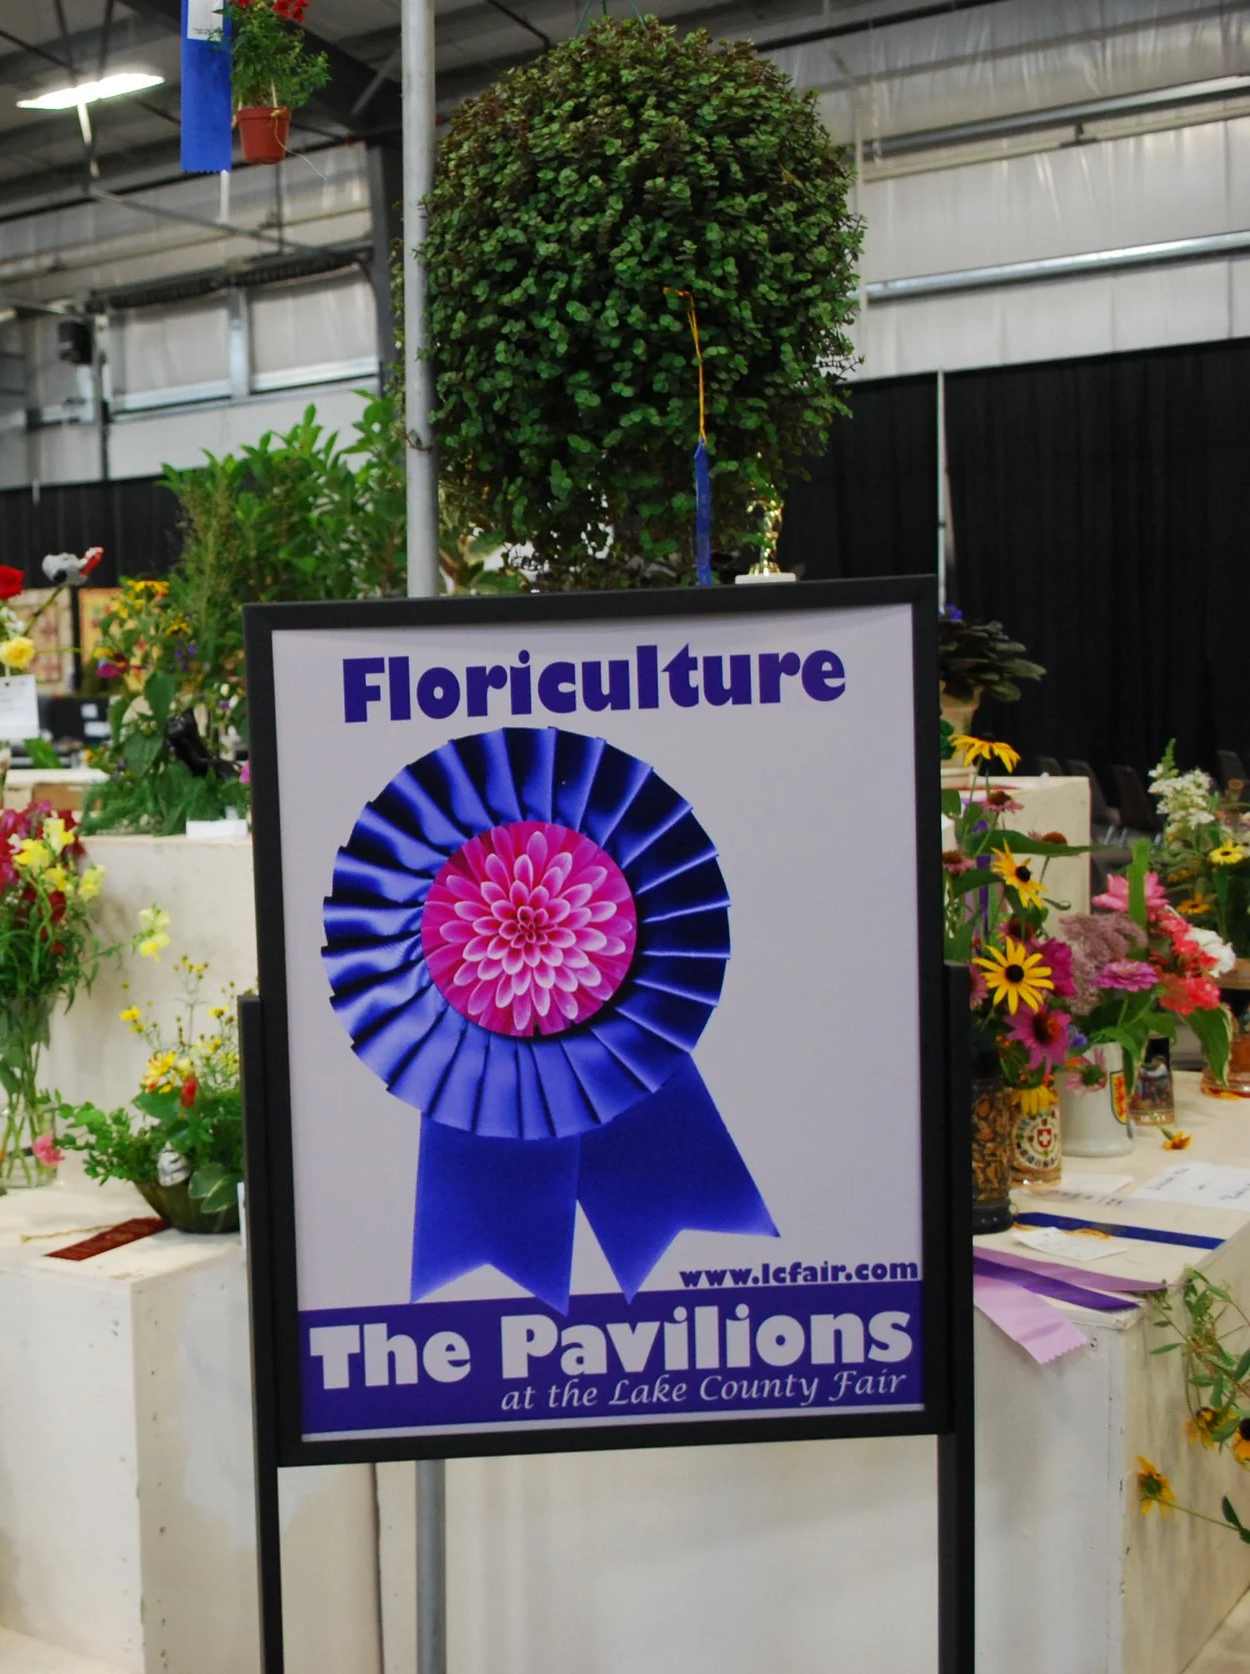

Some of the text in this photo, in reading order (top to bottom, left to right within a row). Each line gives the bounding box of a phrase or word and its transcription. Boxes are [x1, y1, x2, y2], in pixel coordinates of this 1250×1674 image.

[342, 643, 846, 723] Floriculture
[679, 1259, 919, 1287] www.lcfair.com
[309, 1304, 914, 1390] The Pavilions
[501, 1369, 907, 1411] at the Lake County Fair
